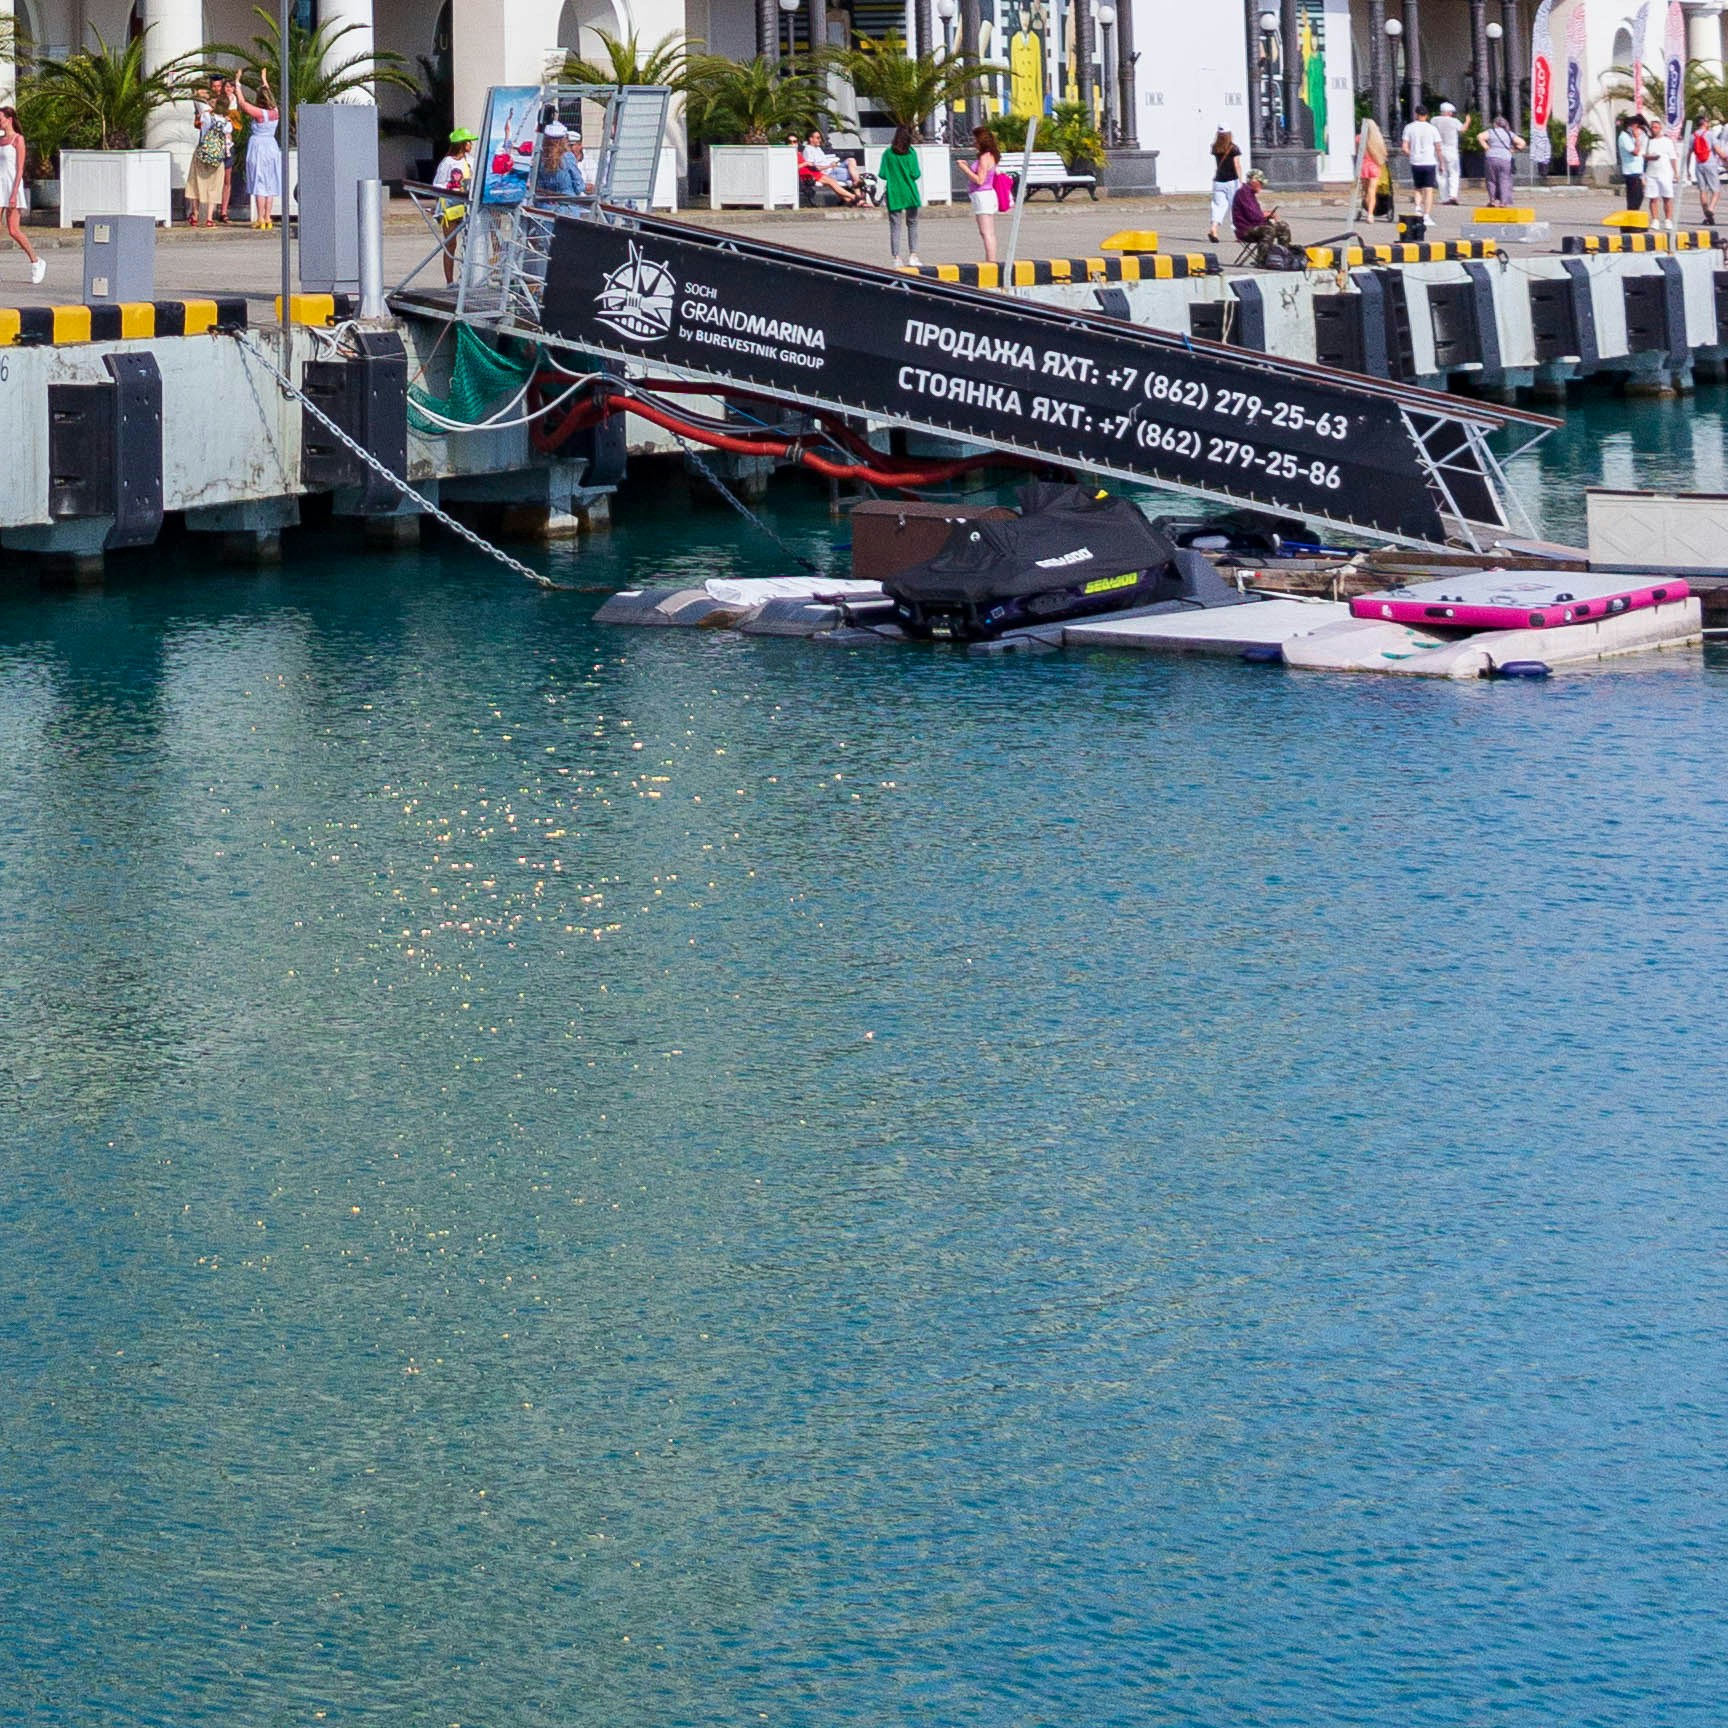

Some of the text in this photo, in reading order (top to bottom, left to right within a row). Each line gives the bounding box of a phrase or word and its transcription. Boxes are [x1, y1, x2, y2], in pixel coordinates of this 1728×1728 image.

[684, 282, 718, 299] SOCHI
[678, 325, 825, 369] by BUREVESTNIK GROUP
[680, 300, 826, 350] GRANDMARINA
[904, 319, 1348, 440] ПРОДАЖА ЯХТ: +7 (862) 279-25-63
[898, 366, 1342, 489] СТОЯНКА ЯХТ: +7 (862) 279-25-86
